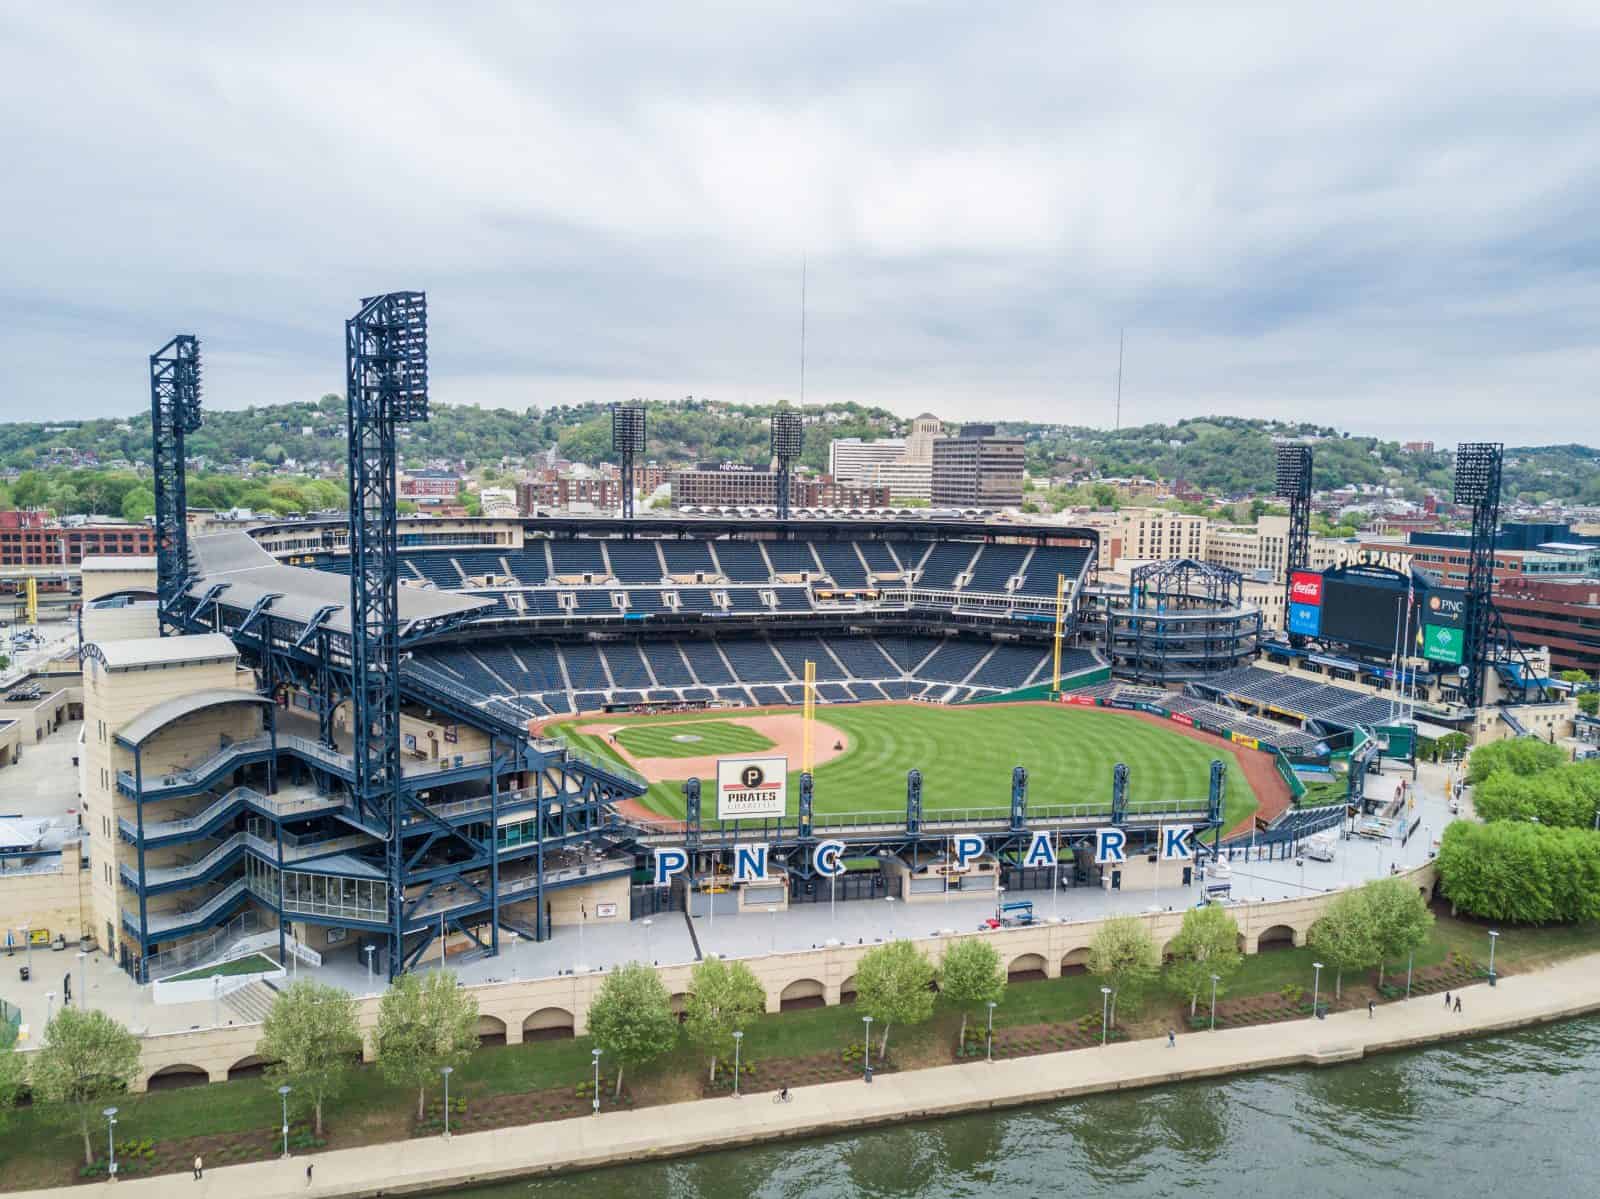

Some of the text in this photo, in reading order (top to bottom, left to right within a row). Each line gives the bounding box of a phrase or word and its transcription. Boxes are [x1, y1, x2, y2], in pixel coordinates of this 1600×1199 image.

[1335, 549, 1414, 578] PNC PARK
[1441, 599, 1464, 612] PNC
[747, 770, 759, 785] P
[728, 791, 776, 802] PIRATES
